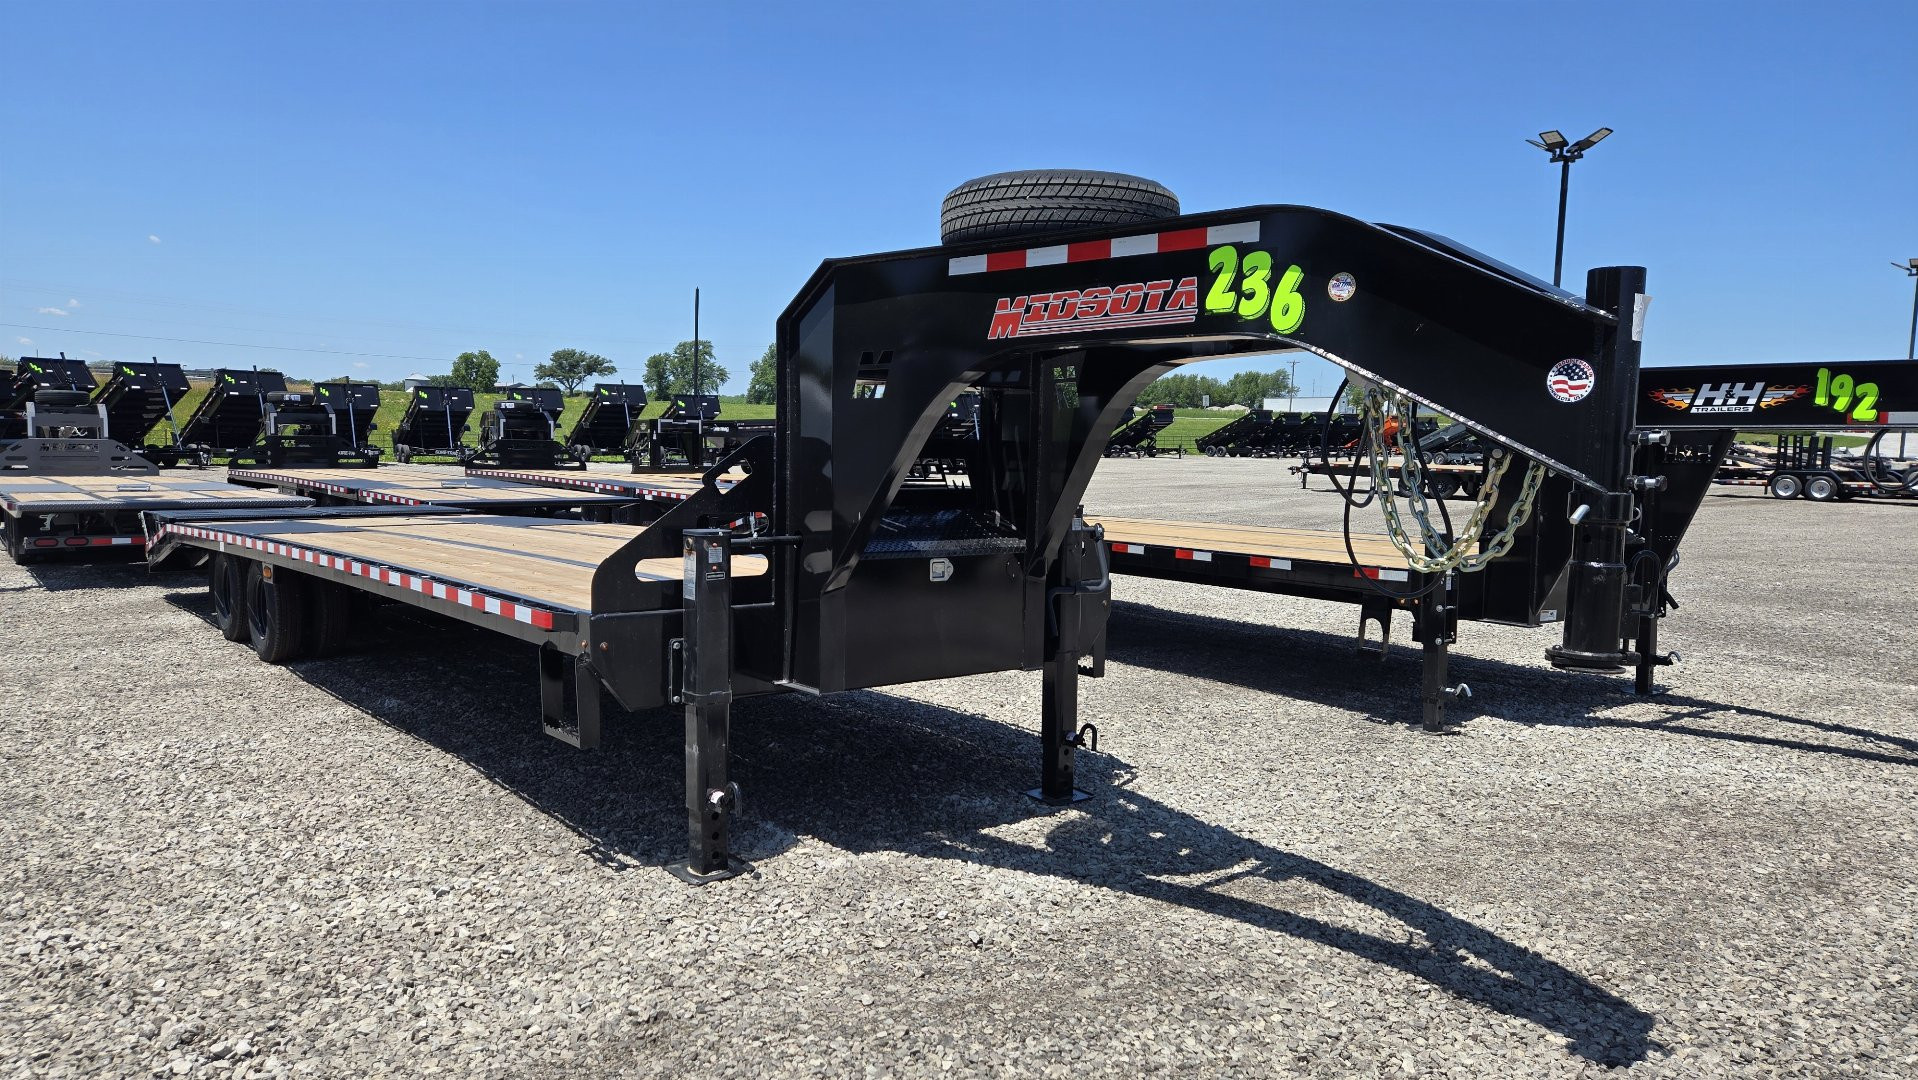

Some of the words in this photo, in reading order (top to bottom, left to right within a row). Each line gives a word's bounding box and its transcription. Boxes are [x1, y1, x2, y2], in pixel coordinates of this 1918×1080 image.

[988, 277, 1197, 339] MIDSOTA
[1205, 245, 1305, 334] 236
[1693, 382, 1765, 406] H&H
[1815, 367, 1879, 422] 192
